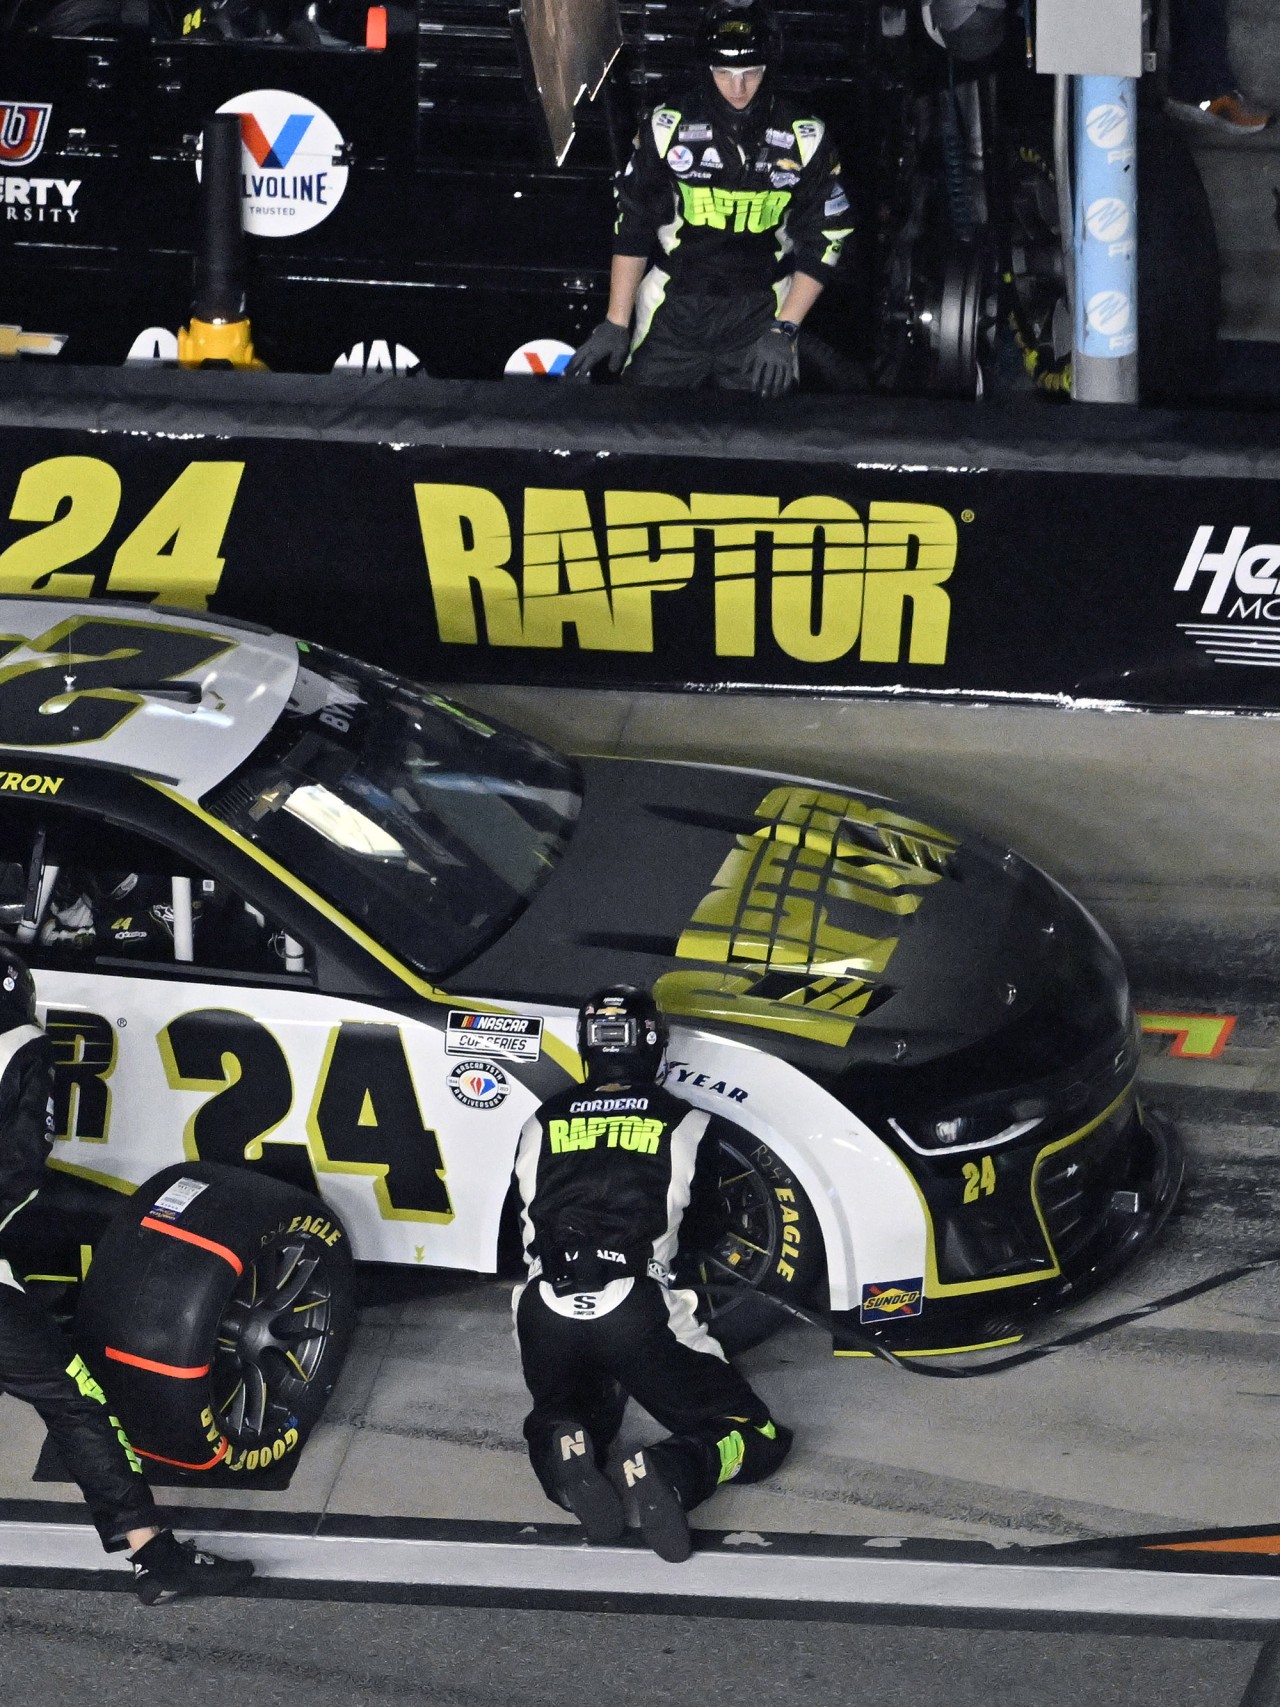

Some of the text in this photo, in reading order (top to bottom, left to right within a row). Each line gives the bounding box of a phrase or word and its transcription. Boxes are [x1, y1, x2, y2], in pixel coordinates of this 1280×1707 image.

[242, 172, 328, 206] LVOLINE
[249, 206, 296, 216] TRUSTED
[414, 482, 958, 665] RAPTOR
[1173, 525, 1280, 614] He
[477, 1017, 529, 1032] NASCAR
[455, 1061, 503, 1081] NASCAR 75TH
[453, 1087, 504, 1109] ANNIVERSARY
[570, 1098, 649, 1114] CORDERO
[156, 1007, 456, 1225] 24
[549, 1115, 663, 1155] RAPTOR
[961, 1155, 997, 1205] 24
[286, 1215, 342, 1247] EAGLE
[774, 1187, 802, 1284] EAGLE
[865, 1291, 917, 1309] SUNOCO
